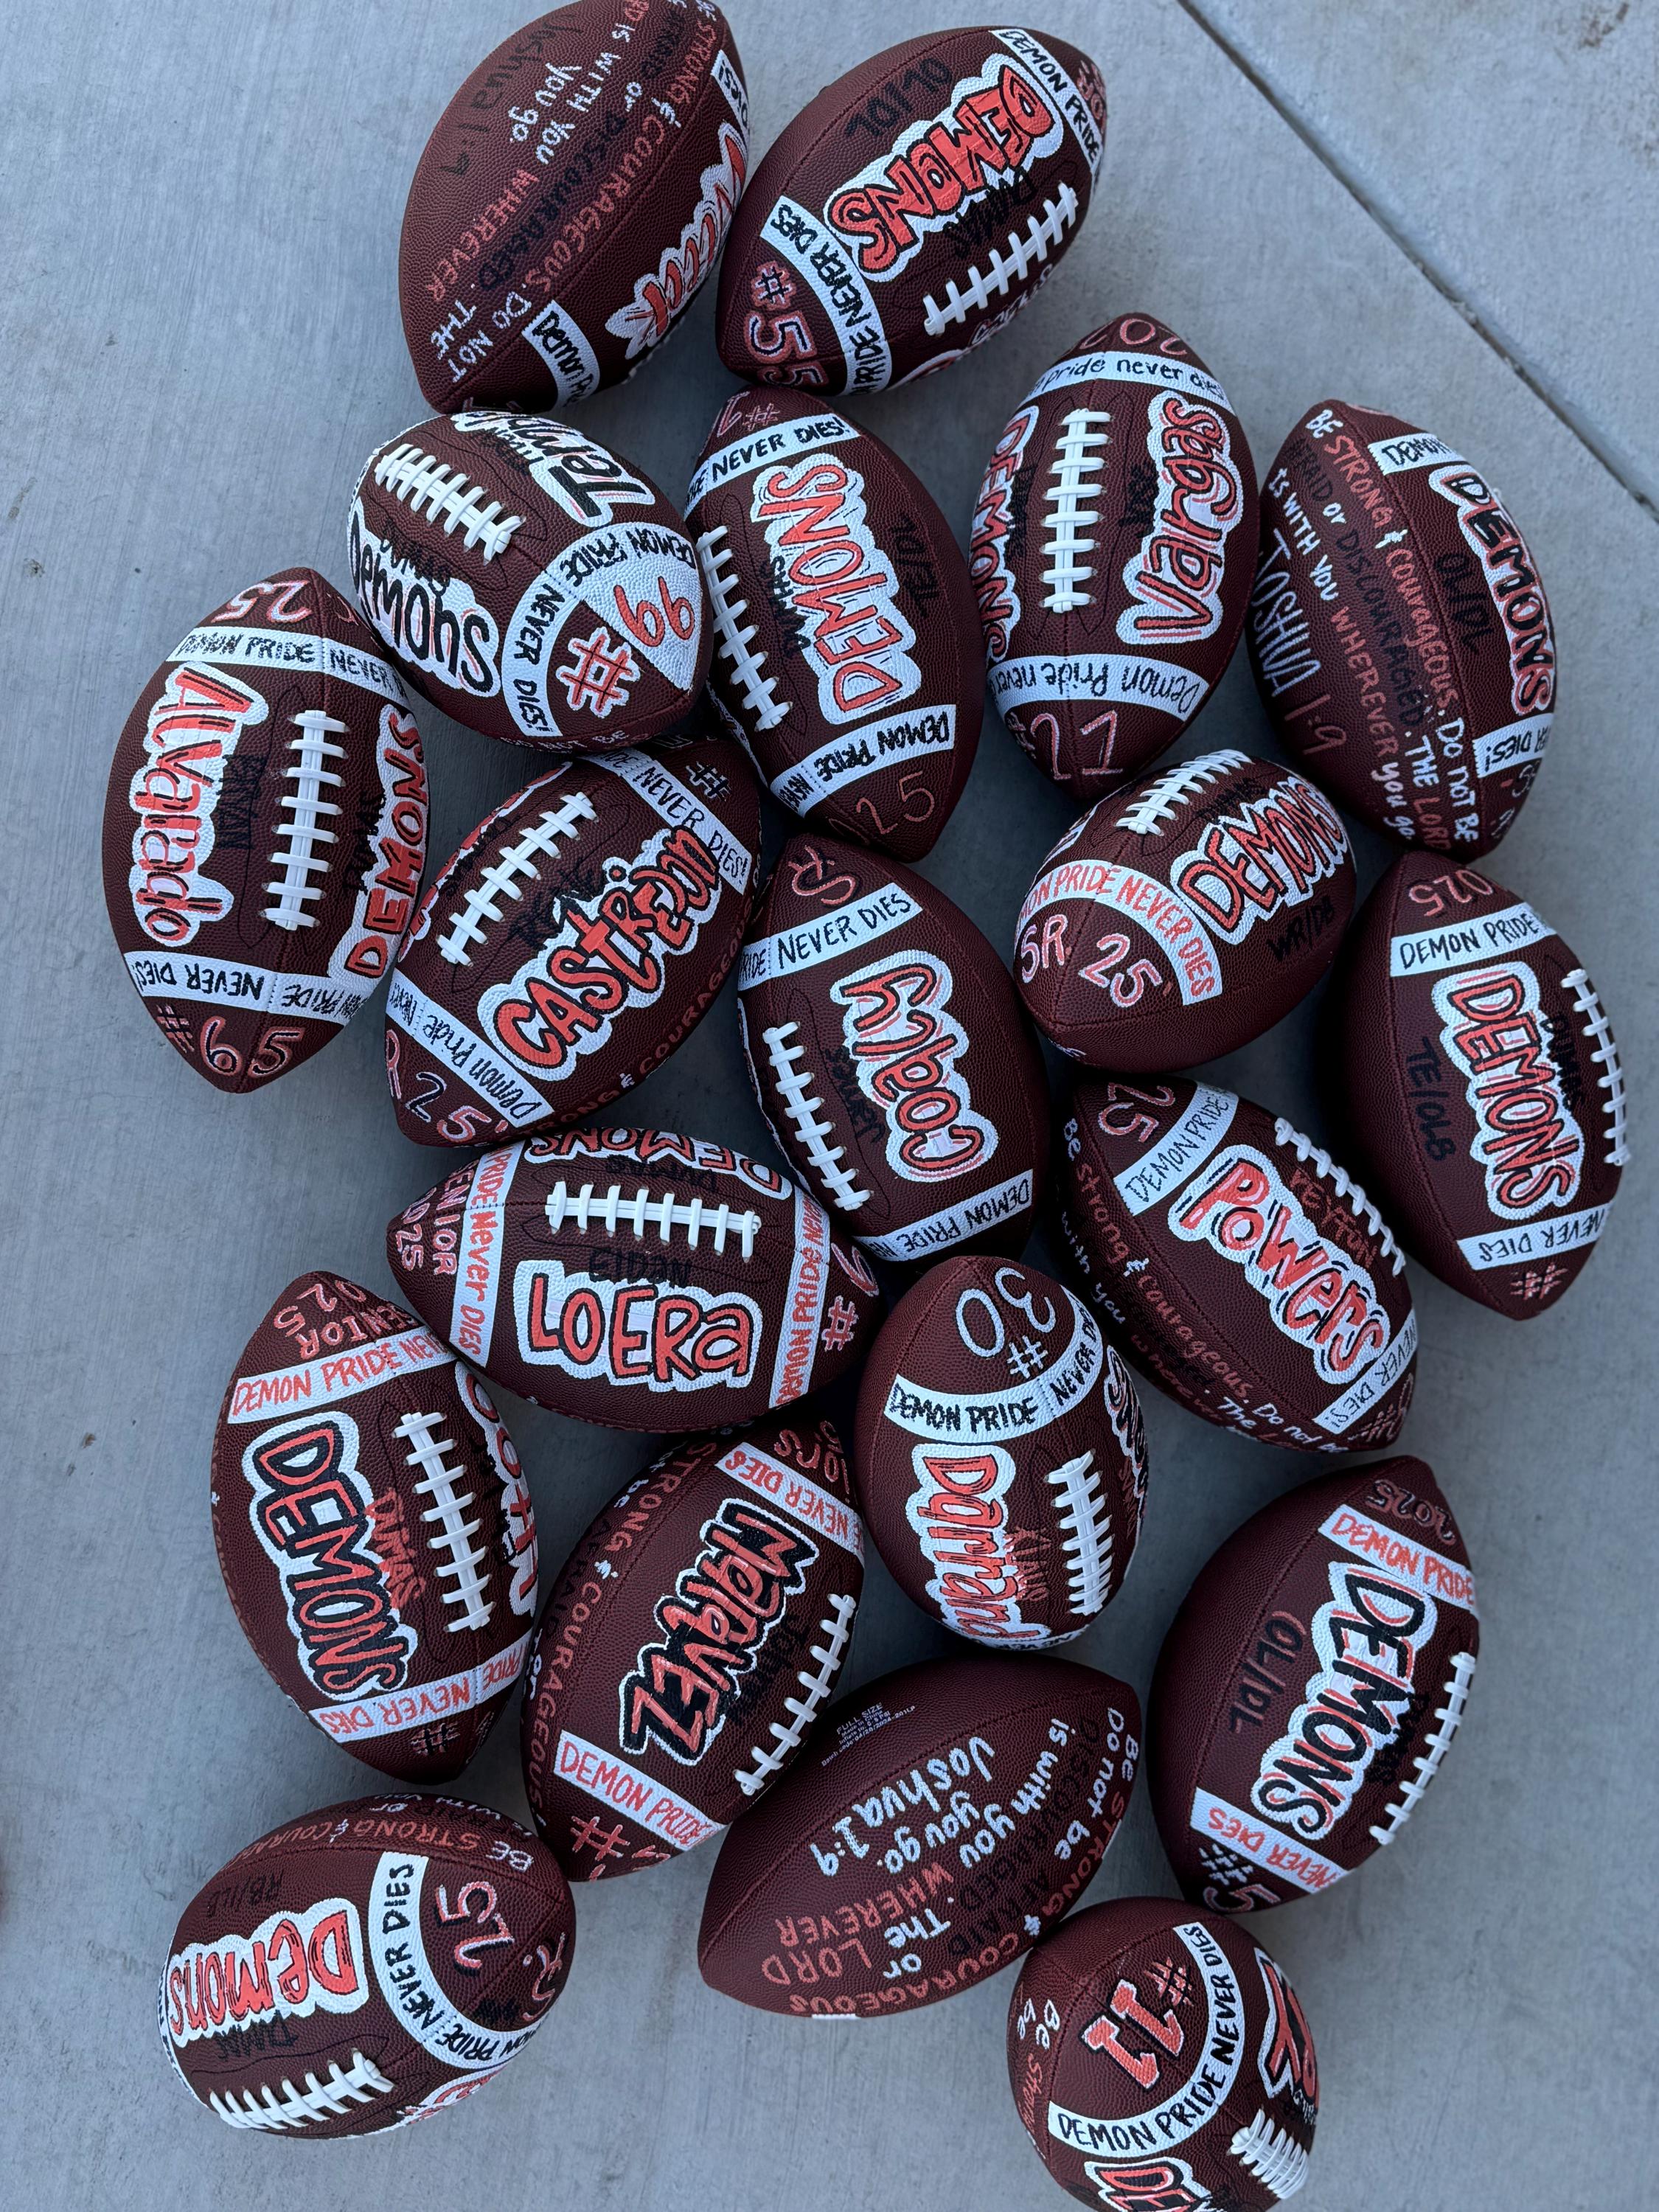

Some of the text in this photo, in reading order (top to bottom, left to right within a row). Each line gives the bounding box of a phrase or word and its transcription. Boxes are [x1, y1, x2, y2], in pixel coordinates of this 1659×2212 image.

[566, 52, 622, 114] WITH
[667, 19, 717, 105] STRONG
[1001, 29, 1068, 94] DEMON
[1065, 94, 1102, 164] PRIDE
[827, 63, 1055, 271] DEMONS
[424, 168, 540, 301] WHEREVER
[429, 300, 477, 360] THE
[493, 291, 532, 330] DO
[447, 329, 493, 383] NOT
[1046, 354, 1183, 387] pride never
[712, 417, 850, 478] NEVER DIES!
[1306, 409, 1343, 439] BE
[1324, 434, 1391, 529] STRONG
[628, 528, 698, 571] DEMON
[969, 411, 1033, 660] DEMONS
[757, 464, 904, 714] DEMONS
[1440, 473, 1554, 716] DEMONS
[513, 584, 566, 665] NEVER
[1280, 493, 1321, 555] WITH
[1330, 608, 1400, 758] WHEREVER
[246, 638, 316, 664] PRIDE
[329, 650, 392, 684] NEVER
[1040, 662, 1108, 696] Pride
[1121, 666, 1200, 714] Demon
[513, 678, 554, 733] DIES!
[879, 710, 950, 757] DEMON
[1283, 694, 1348, 756] 1:9
[1405, 734, 1441, 788] THE
[1485, 732, 1531, 773] DIES!
[343, 710, 429, 978] DEMONS
[634, 766, 749, 886] NEVER DIES!
[1180, 777, 1345, 934] DEMONS
[1453, 812, 1480, 843] BE
[776, 892, 913, 970] NEVER DIES
[1054, 865, 1216, 999] PRIDE NEVER DIES
[1399, 911, 1540, 972] DEMON PRIDE
[133, 961, 336, 1017] PRIDE NEVER DIES!
[156, 1004, 305, 1079] #65
[1448, 970, 1580, 1211] DEMONS
[529, 1128, 783, 1193] DEMONS
[1124, 1140, 1200, 1203] DEMON
[1183, 1091, 1230, 1142] PRIDE
[896, 1177, 1032, 1253] DEMON PRIDE
[1478, 1209, 1607, 1263] NEVER DIES
[456, 1305, 487, 1357] DIES
[1074, 1161, 1132, 1266] strong
[1251, 1402, 1281, 1427] Do
[1281, 1423, 1316, 1444] not
[1090, 1283, 1126, 1325] you
[234, 1349, 401, 1418] DEMON PRIDE
[889, 1344, 1097, 1433] DEMON PRIDE NEVER
[1216, 1397, 1256, 1429] The
[1325, 1380, 1375, 1430] DIES!
[609, 1441, 719, 1553] STRONG
[725, 1449, 849, 1542] NEVER DIES
[258, 1419, 411, 1694] DEMONS
[1331, 1514, 1476, 1604] DEMON PRIDE
[319, 1705, 371, 1736] DIES
[383, 1676, 473, 1728] NEVER
[836, 1701, 883, 1735] FULL SIZE
[1258, 1565, 1427, 1836] DEMONS
[821, 1750, 839, 1767] Batch
[559, 1740, 715, 1845] DEMON PRIDE
[352, 1818, 482, 1851] STRONG
[485, 1840, 535, 1874] BE
[1208, 1806, 1344, 1891] NEVER DIES
[774, 1861, 956, 1949] WHEREVER
[382, 1863, 499, 2062] PRIDE NEVER DIES
[761, 1937, 873, 1988] LORD
[787, 1931, 1020, 2014] COURAGEOUS
[1182, 1924, 1224, 1969] DIES
[1208, 1975, 1242, 2067] NEVER
[1057, 2112, 1158, 2152] DEMON
[1153, 2070, 1229, 2140] PRIDE
